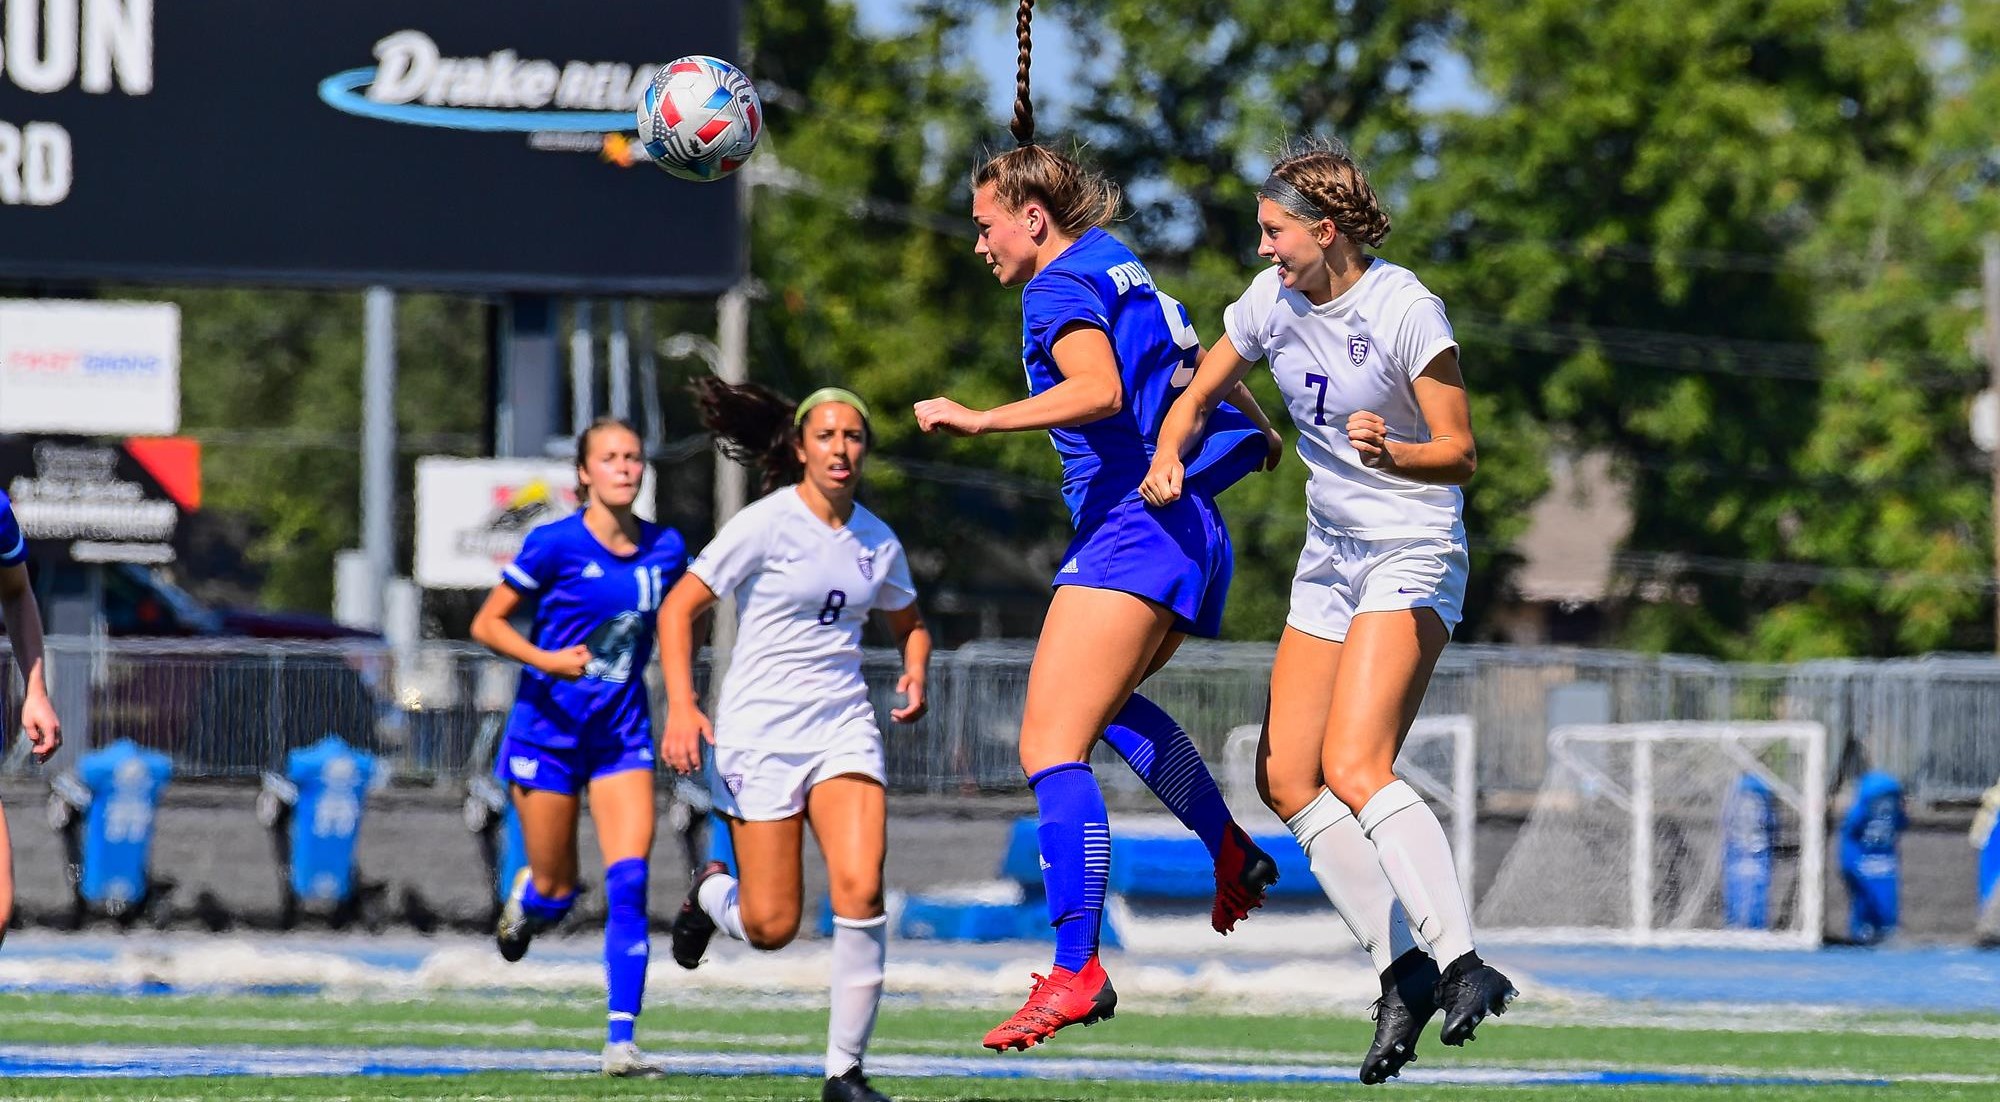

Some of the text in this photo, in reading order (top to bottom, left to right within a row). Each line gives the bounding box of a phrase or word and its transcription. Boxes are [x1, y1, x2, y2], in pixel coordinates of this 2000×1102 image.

[364, 29, 560, 108] Drake
[1305, 372, 1329, 426] 7
[634, 565, 662, 612] 11
[818, 589, 846, 626] 8
